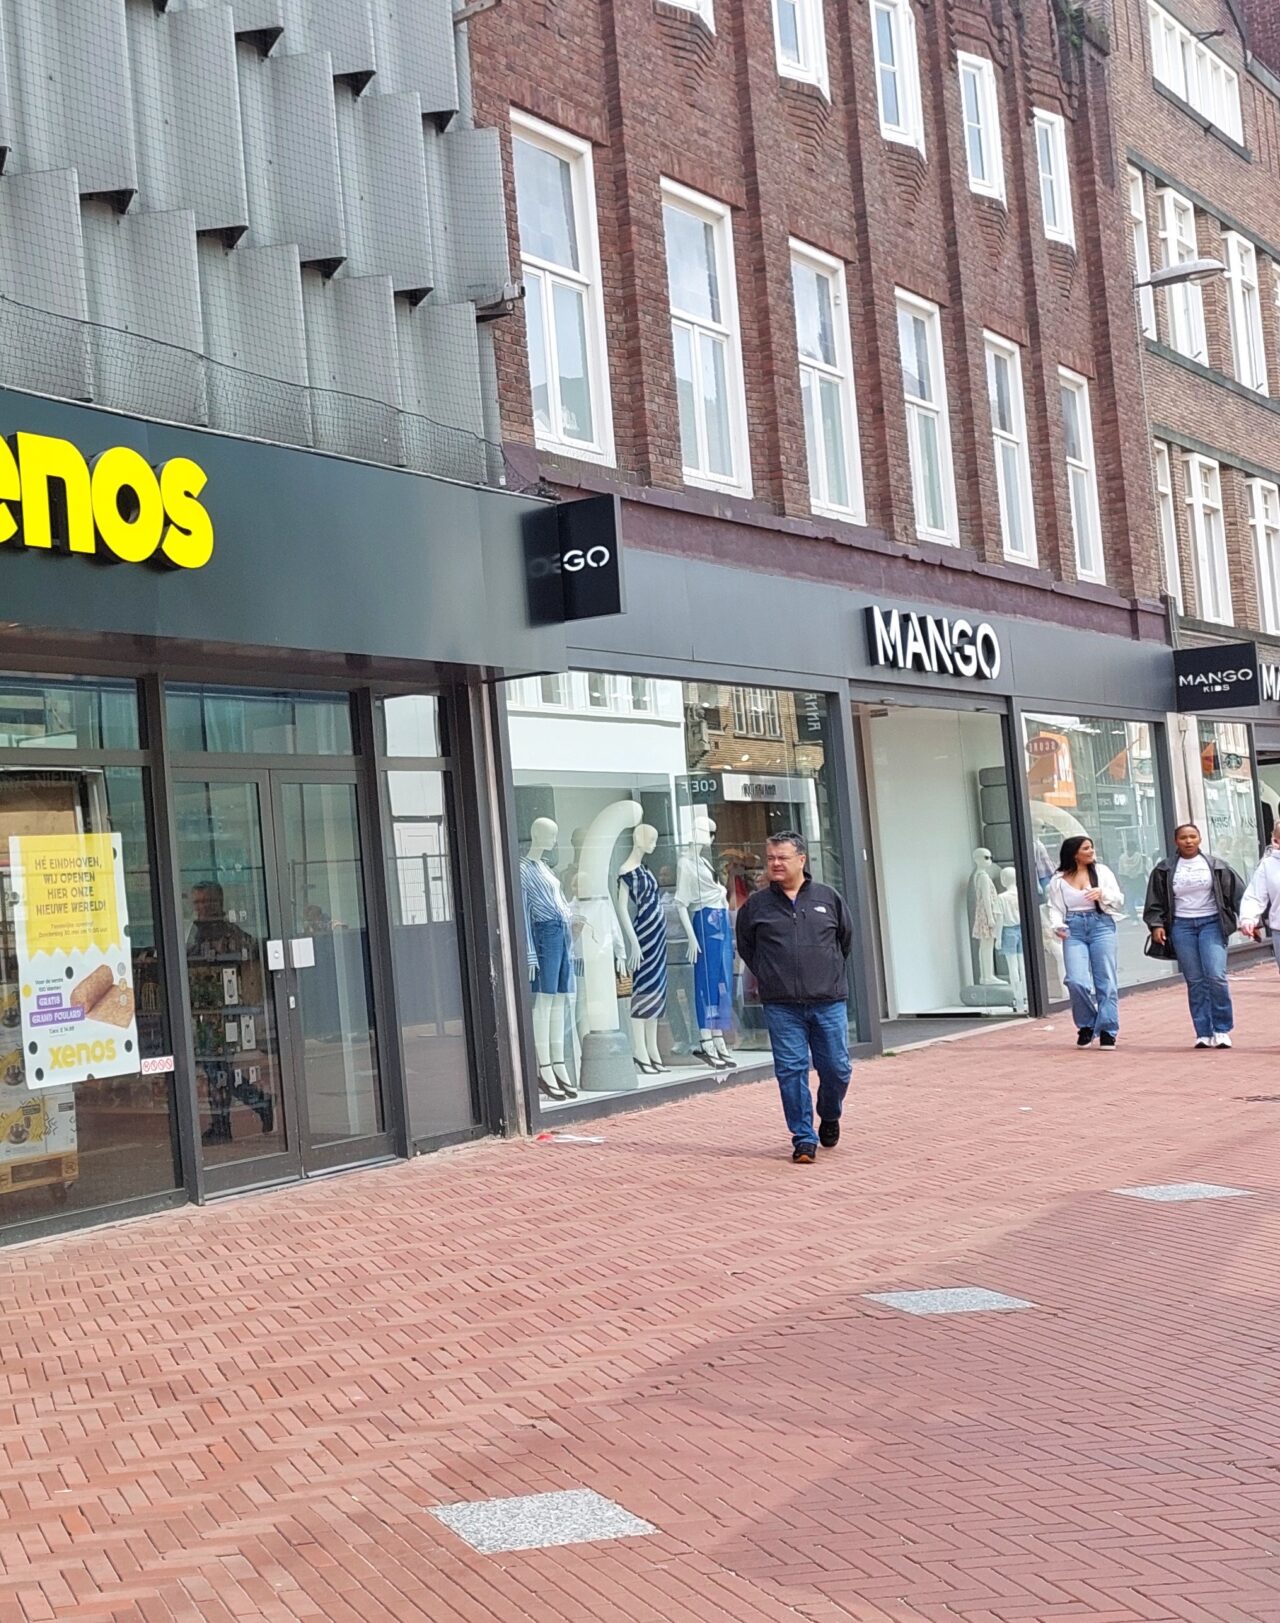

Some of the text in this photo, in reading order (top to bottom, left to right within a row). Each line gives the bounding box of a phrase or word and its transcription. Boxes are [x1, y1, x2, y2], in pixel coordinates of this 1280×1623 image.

[869, 605, 1001, 679] MANGO
[1179, 668, 1253, 687] MANGO
[35, 856, 102, 870] HÉ EINDHOVEN,
[43, 871, 96, 884] WIJ OPENEN
[47, 885, 94, 900] HIER ONZE
[36, 900, 107, 916] NIEUWE WERELD!
[48, 1038, 117, 1071] xenos
